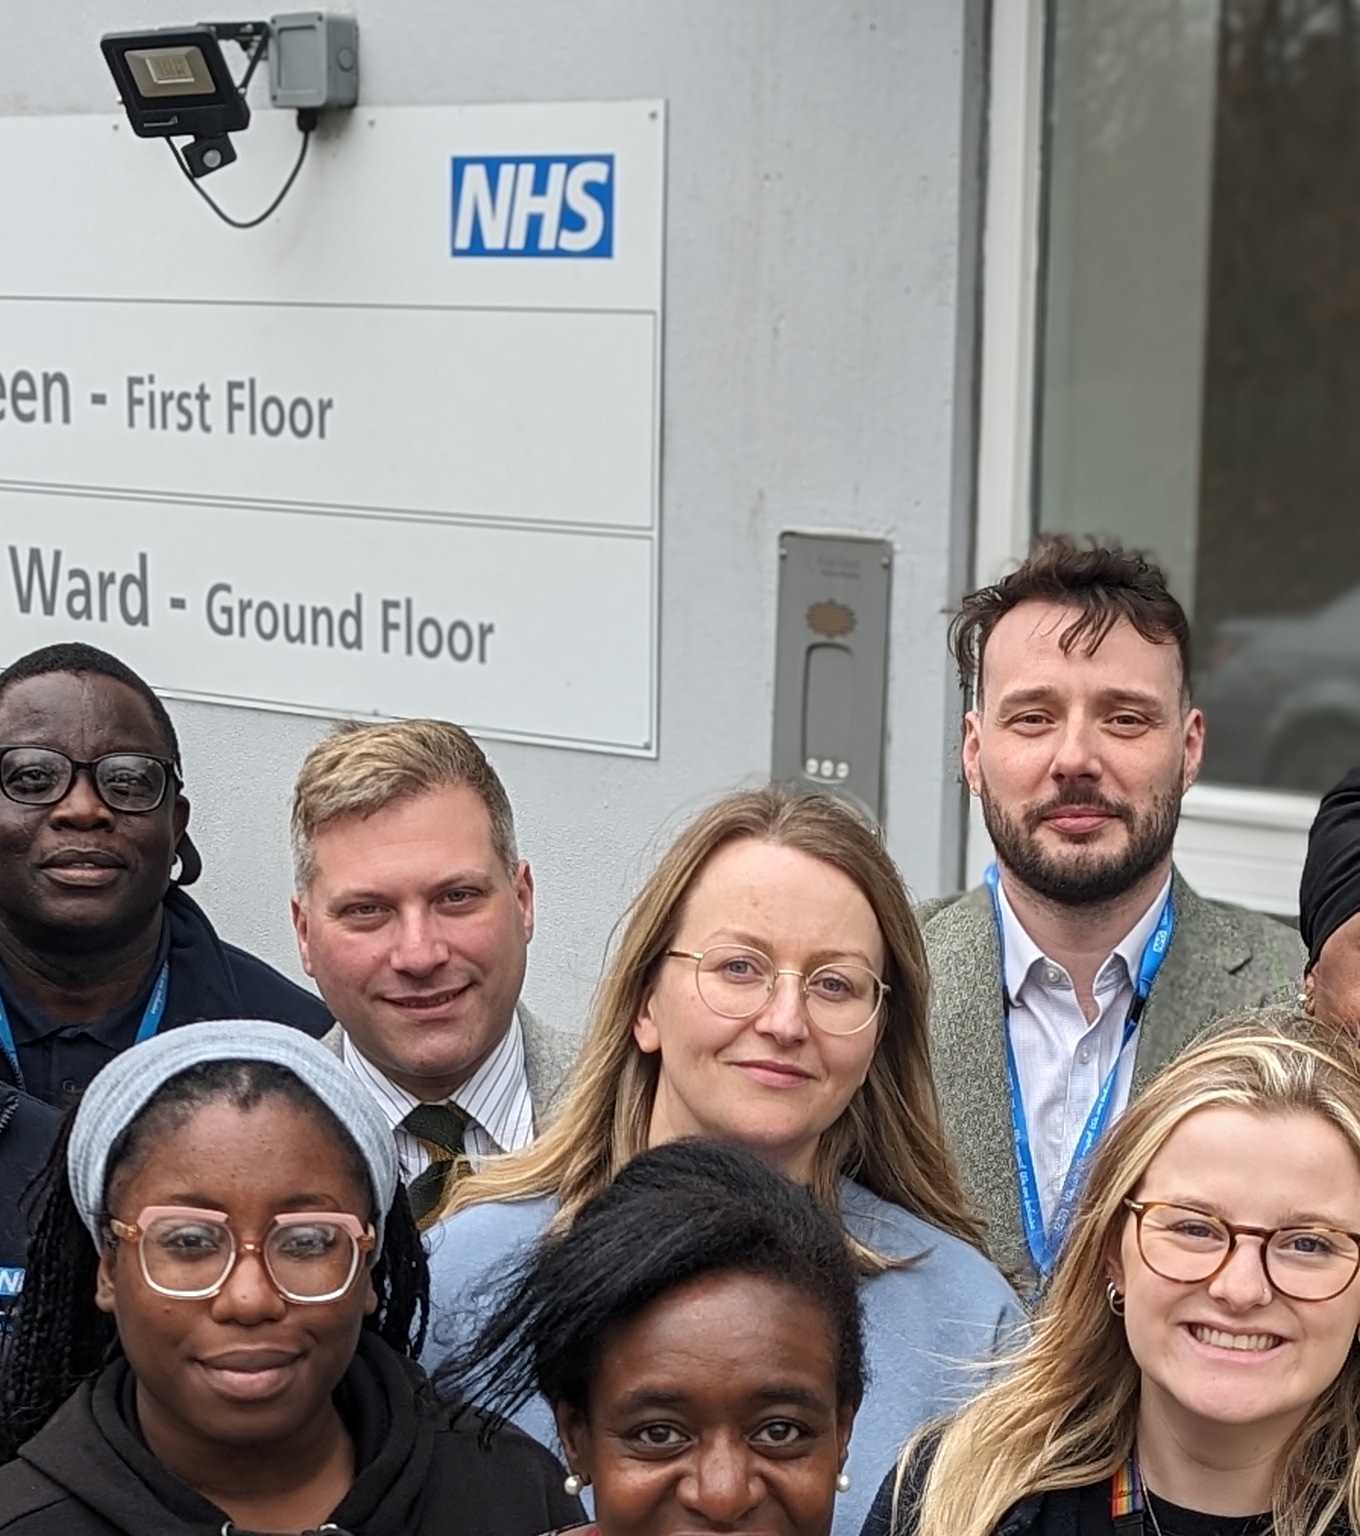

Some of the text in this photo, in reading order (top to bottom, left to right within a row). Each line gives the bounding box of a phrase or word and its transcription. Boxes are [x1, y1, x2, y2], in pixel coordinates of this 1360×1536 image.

[453, 160, 611, 253] NHS
[126, 374, 212, 434] First
[226, 377, 334, 440] Floor
[8, 544, 151, 628] Ward
[205, 582, 364, 652] Ground
[380, 597, 495, 665] Floor
